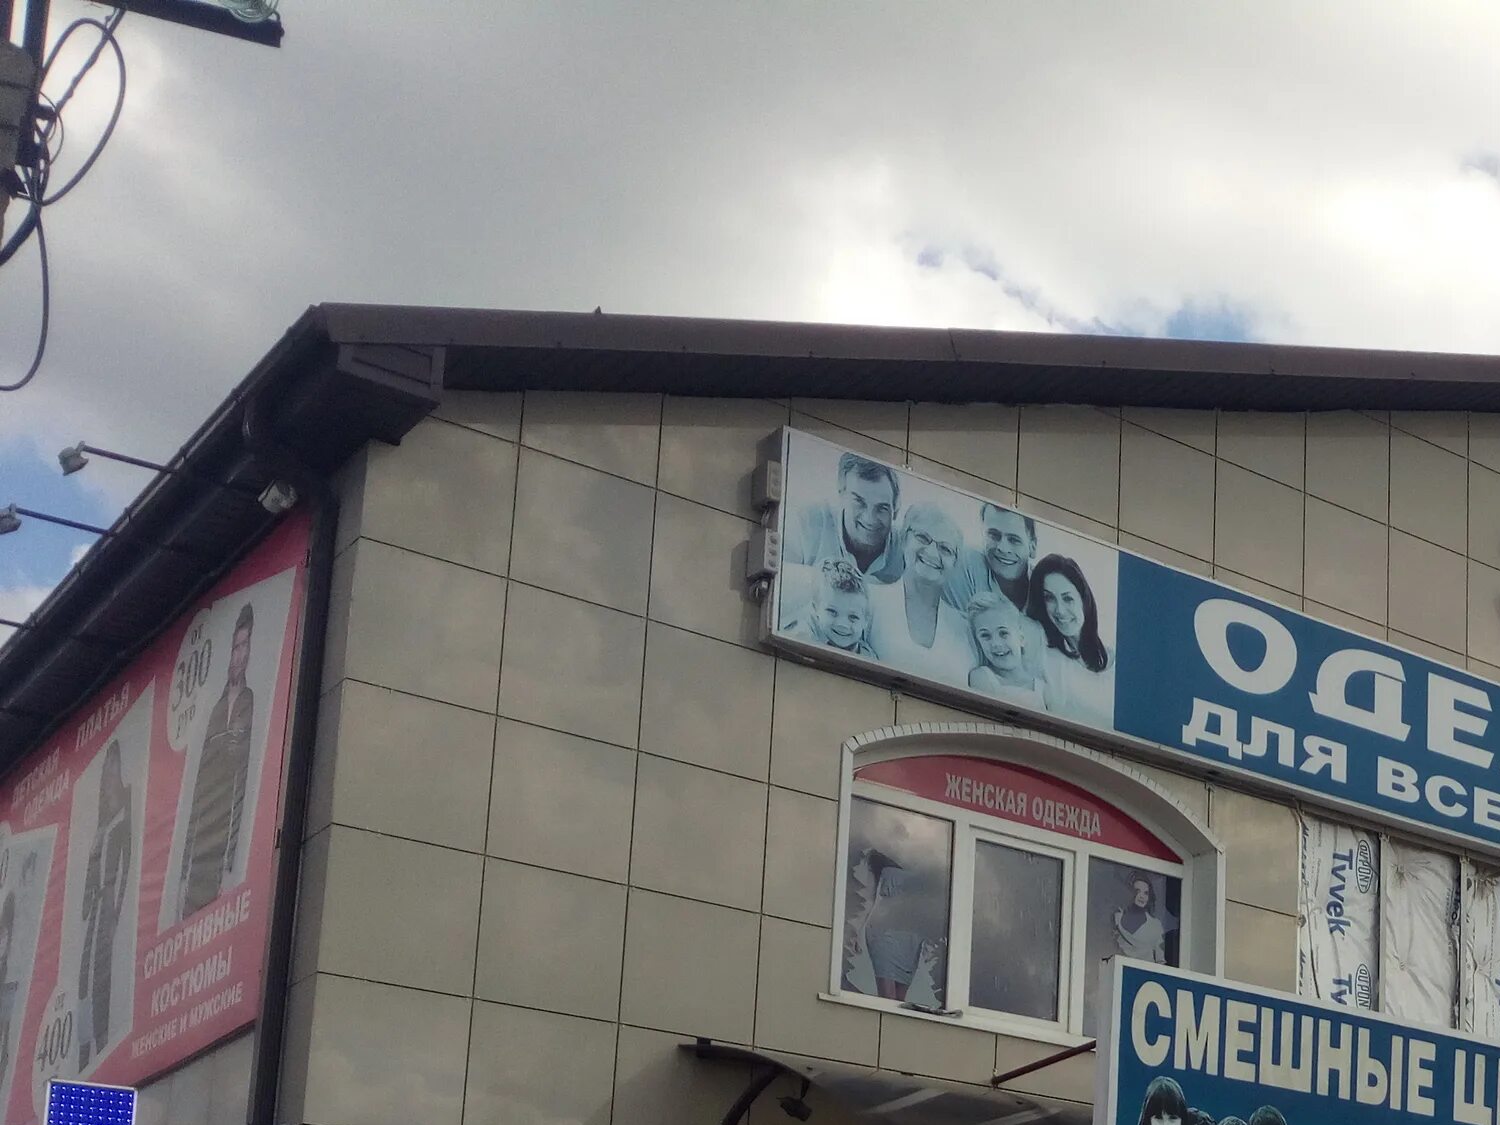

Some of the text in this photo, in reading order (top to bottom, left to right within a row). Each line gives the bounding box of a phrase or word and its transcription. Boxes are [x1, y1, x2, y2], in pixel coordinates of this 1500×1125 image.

[172, 639, 212, 710] 300
[1182, 697, 1348, 784] ДЛЯ
[945, 773, 1102, 837] ЖЕНСКАЯ ОДЕЖДА
[143, 889, 251, 980] СПОРТИВНЫЕ
[151, 946, 233, 1017] КОСТЮМЫ
[37, 1010, 73, 1072] 400
[1131, 980, 1437, 1118] СМЕШНЫЕ
